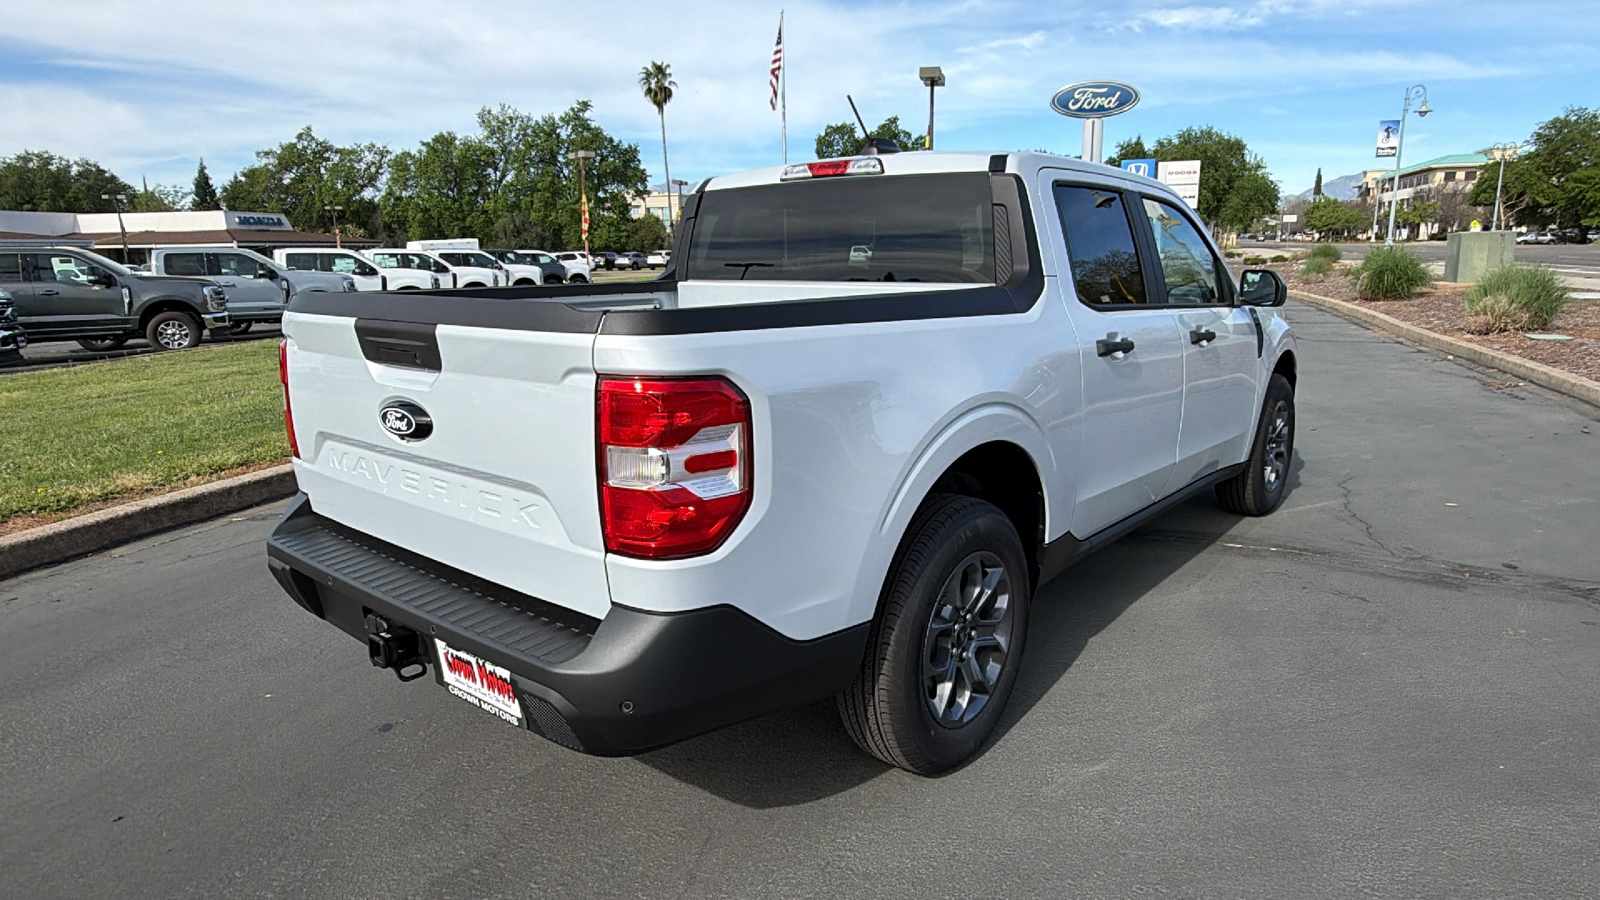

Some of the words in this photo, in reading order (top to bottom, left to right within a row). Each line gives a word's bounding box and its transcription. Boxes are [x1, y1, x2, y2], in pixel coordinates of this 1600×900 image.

[1068, 87, 1121, 110] Ford
[237, 216, 284, 225] HONDA
[385, 411, 408, 431] Ford
[328, 447, 540, 529] MAVERICK
[444, 650, 477, 685] Crown
[476, 658, 516, 704] Motors
[448, 684, 480, 707] CROWN
[480, 700, 519, 726] MOTORS
